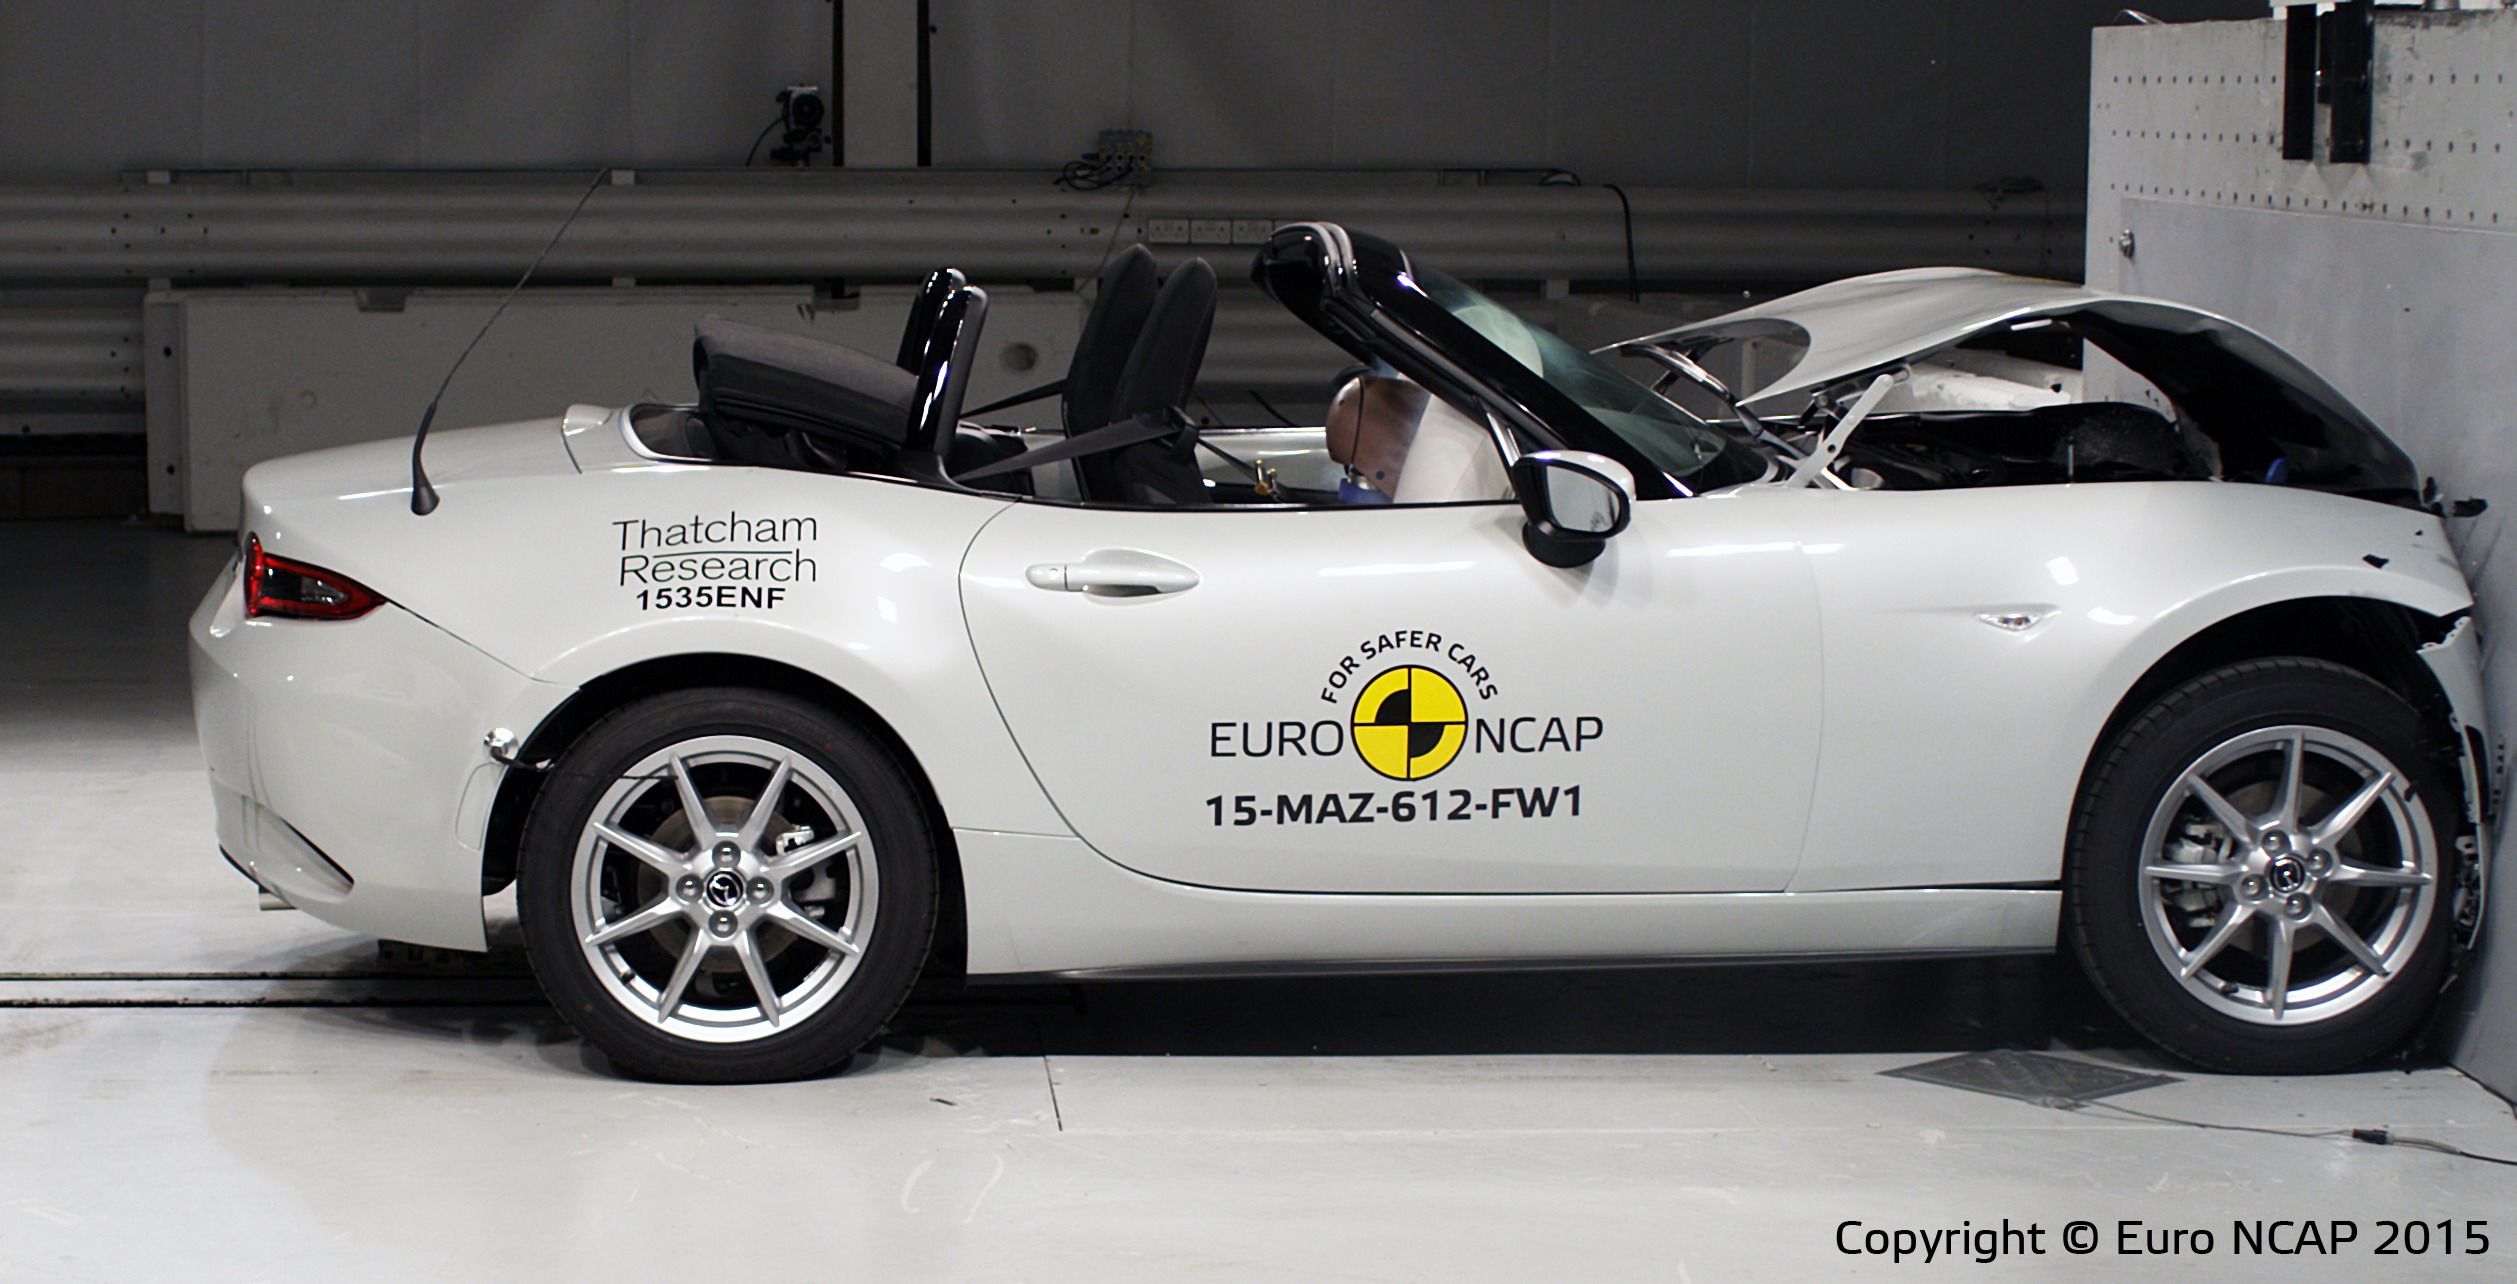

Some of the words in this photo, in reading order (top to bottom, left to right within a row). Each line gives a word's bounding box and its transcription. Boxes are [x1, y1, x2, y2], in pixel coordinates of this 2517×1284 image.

[612, 511, 818, 550] Thatcham
[620, 548, 817, 587] Research
[636, 585, 787, 611] 1535ENF
[1321, 655, 1360, 704] FOR
[1360, 630, 1442, 660] SAFER
[1447, 643, 1498, 700] CARS
[1210, 720, 1345, 758] EURO
[1475, 716, 1604, 754] NCAP
[1206, 784, 1582, 827] 15-MAZ-612-FW1
